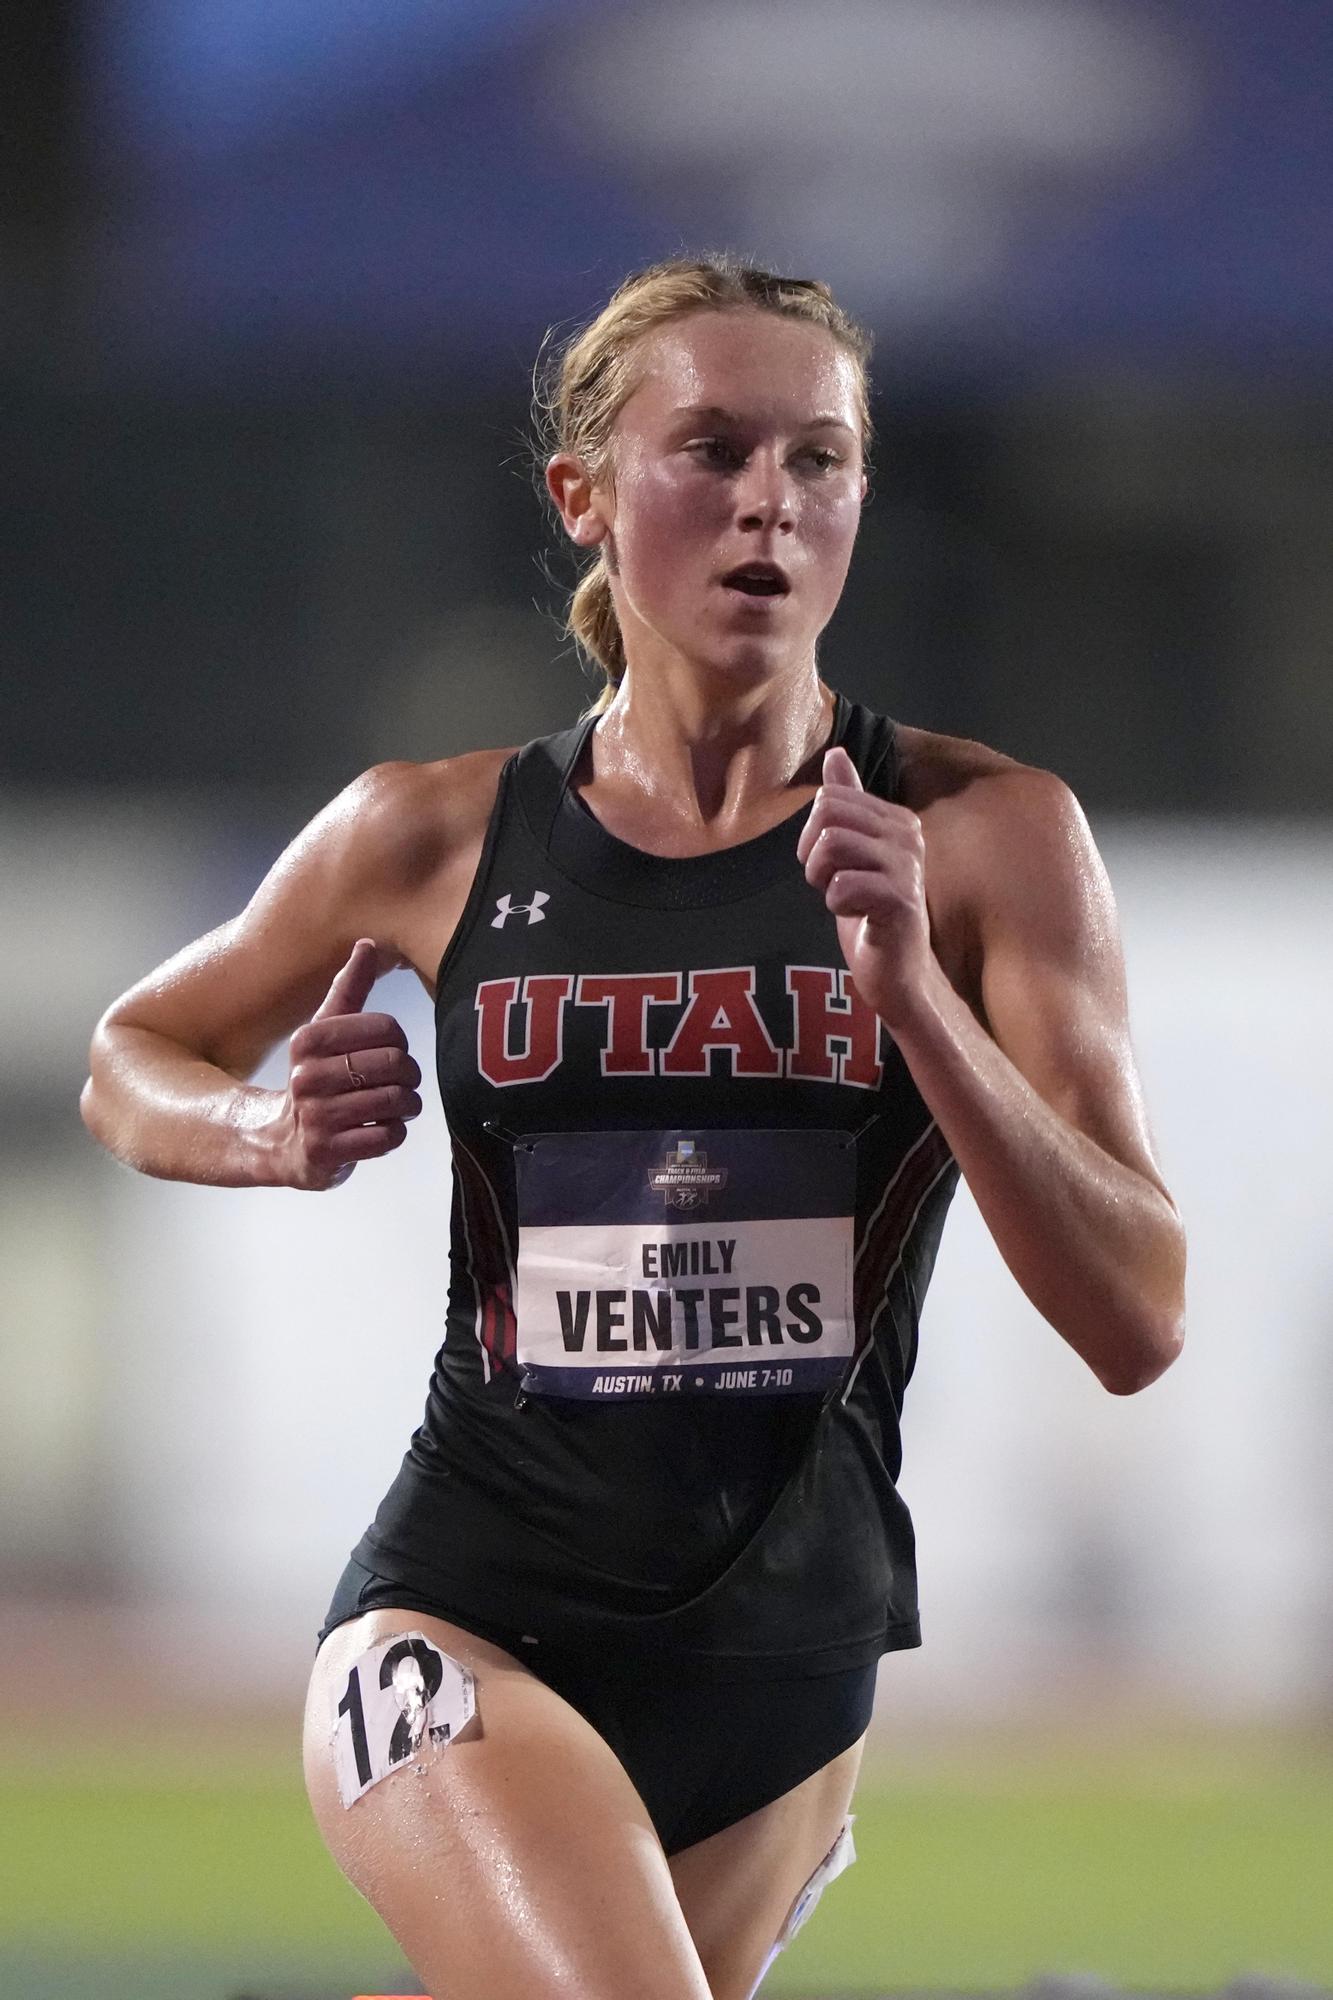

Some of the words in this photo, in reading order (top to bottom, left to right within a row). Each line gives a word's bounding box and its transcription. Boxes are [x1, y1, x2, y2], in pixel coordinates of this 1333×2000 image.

[475, 965, 884, 1091] UTAH
[655, 1174, 721, 1184] CHAMPIONSHIPS
[642, 1239, 736, 1278] EMILY
[556, 1283, 823, 1352] VENTERS
[592, 1376, 656, 1393] AUSTIN,
[662, 1375, 683, 1392] TX
[715, 1370, 757, 1389] JUNE
[761, 1368, 793, 1387] 7-10
[339, 1638, 450, 1788] 12
